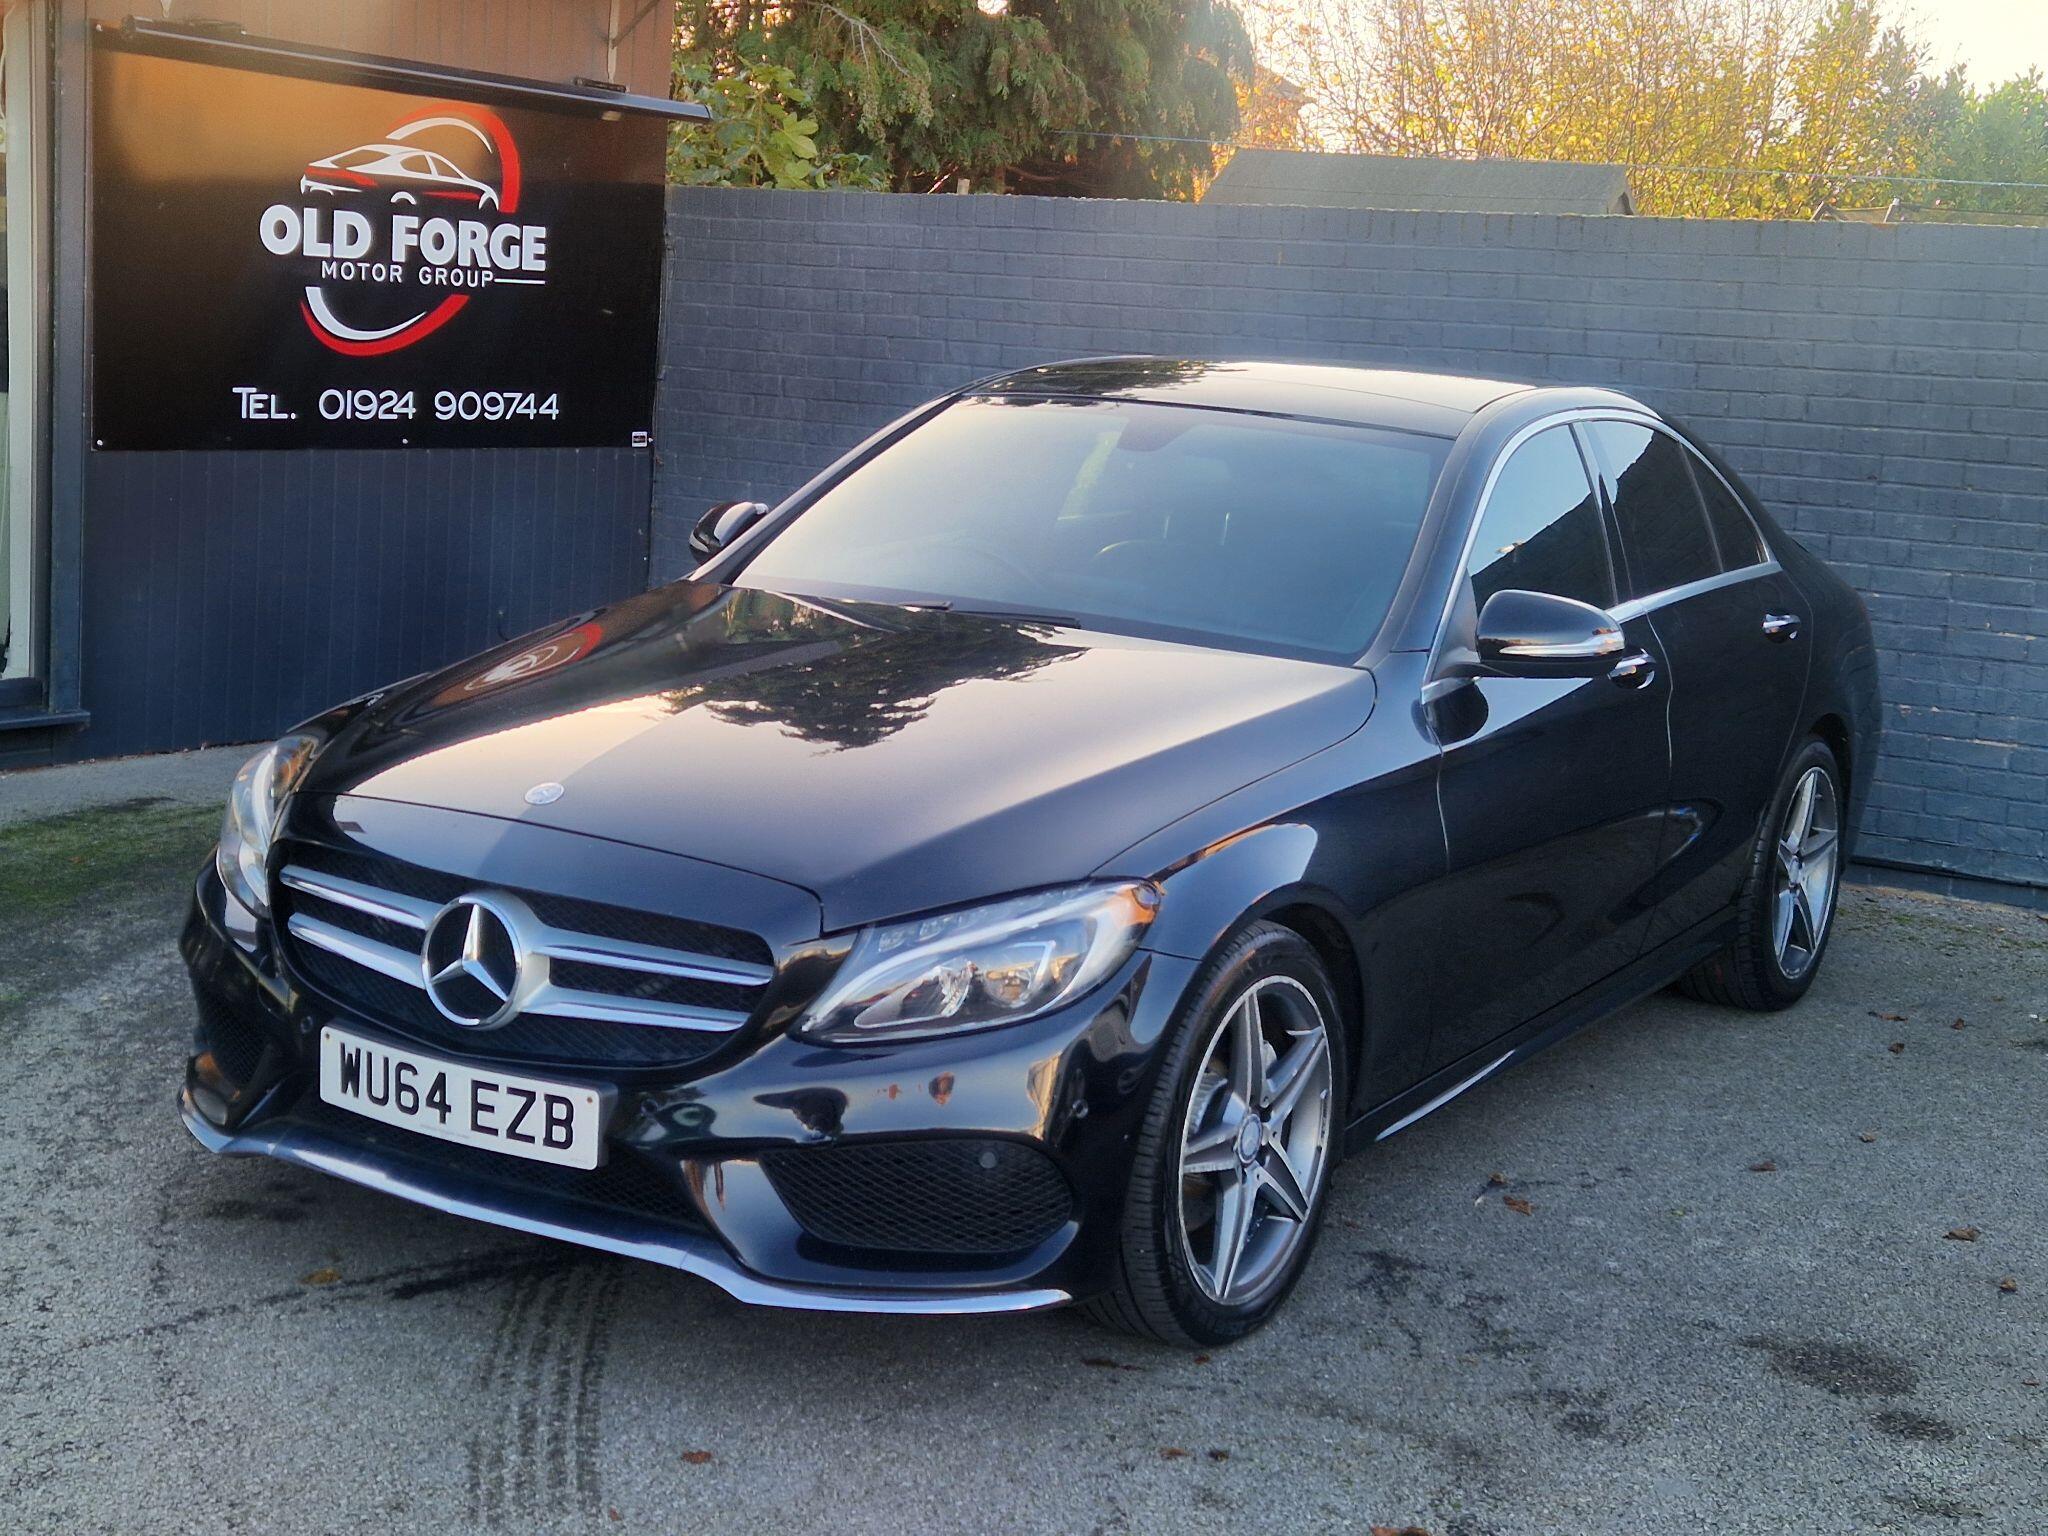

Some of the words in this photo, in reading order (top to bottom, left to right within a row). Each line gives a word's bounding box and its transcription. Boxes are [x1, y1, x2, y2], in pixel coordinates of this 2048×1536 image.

[260, 204, 372, 258] OLD
[391, 214, 547, 271] FORGE
[321, 260, 403, 283] MOTOR
[418, 266, 495, 289] GROUP
[318, 388, 417, 421] 01924
[434, 390, 560, 421] 909744
[340, 1042, 452, 1125] WU64
[470, 1079, 574, 1150] EZB
